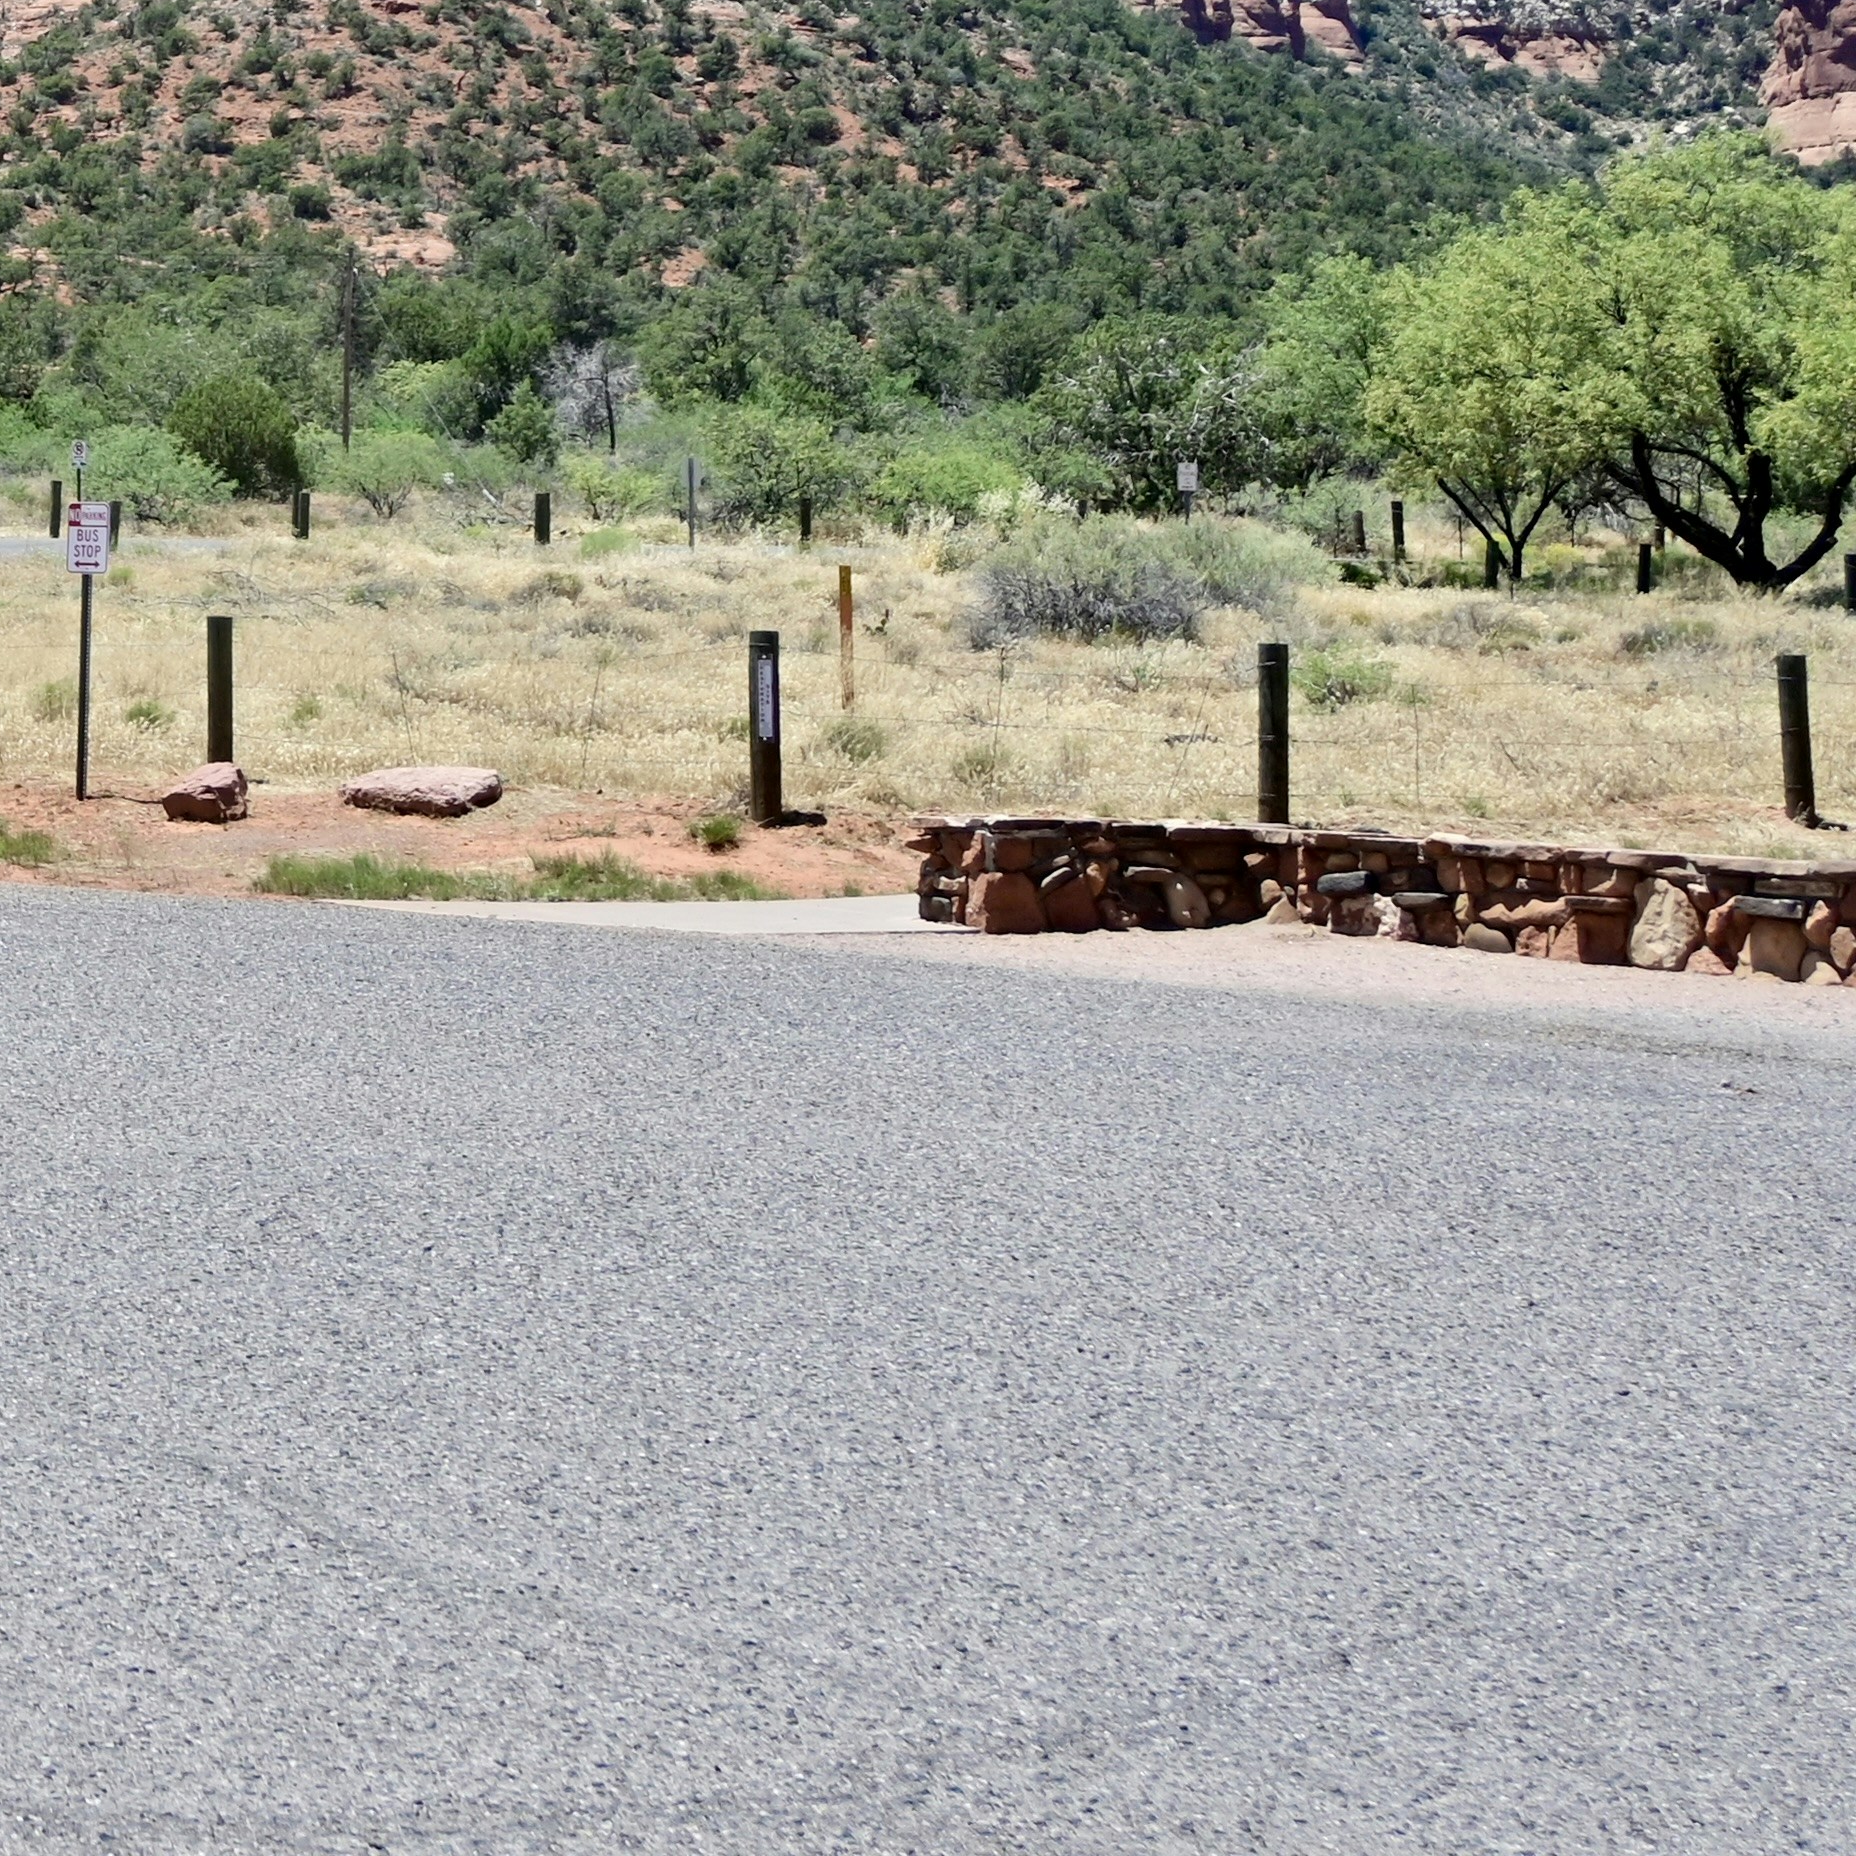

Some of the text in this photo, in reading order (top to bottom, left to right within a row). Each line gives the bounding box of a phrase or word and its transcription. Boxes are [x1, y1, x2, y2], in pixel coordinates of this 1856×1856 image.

[70, 508, 106, 522] NO PARKING
[77, 529, 99, 542] BUS
[74, 544, 101, 558] STOP
